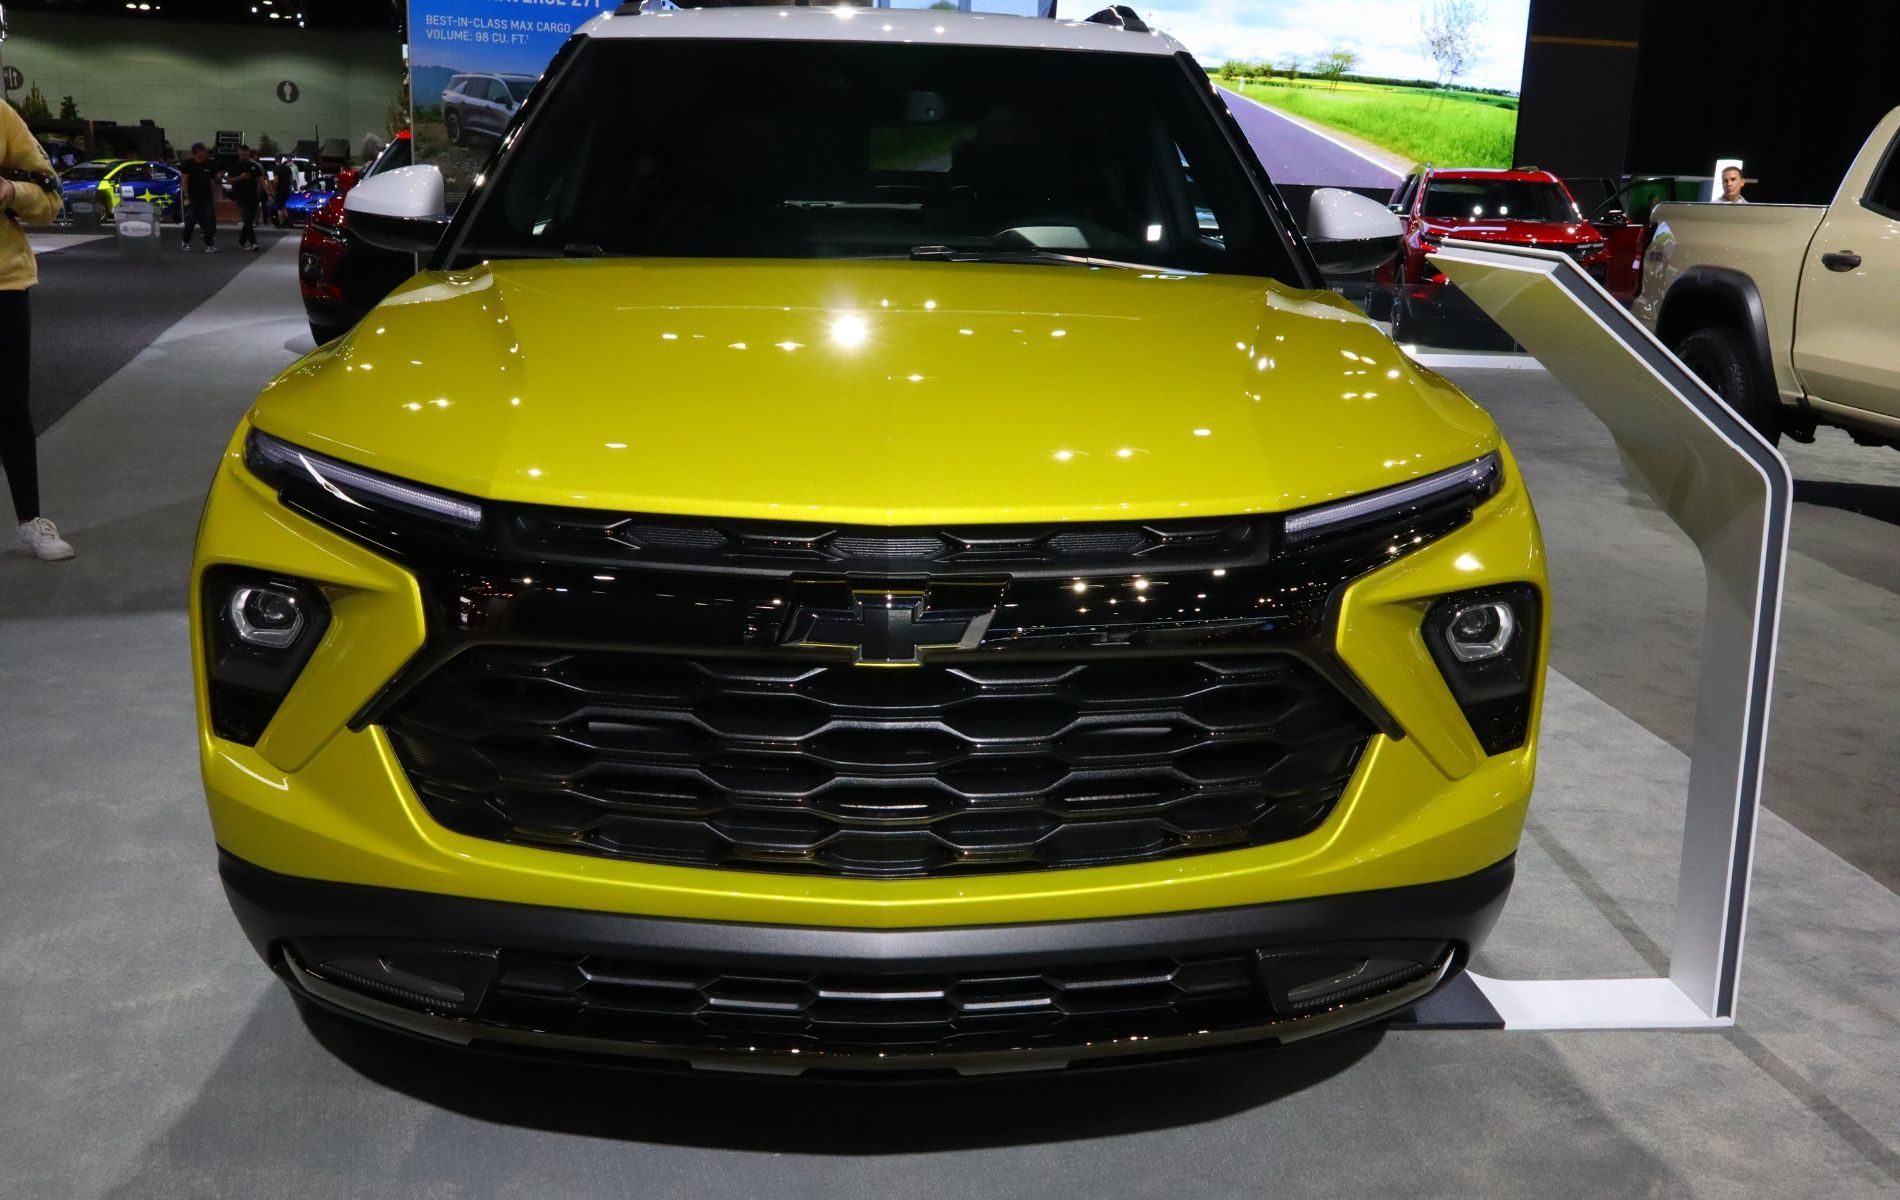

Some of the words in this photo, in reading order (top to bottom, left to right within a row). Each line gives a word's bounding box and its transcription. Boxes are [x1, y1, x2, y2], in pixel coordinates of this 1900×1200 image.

[426, 14, 508, 29] BEST-IN-CLASS
[510, 20, 534, 31] MAX
[537, 21, 571, 33] CARGO
[426, 29, 473, 41] VOLUME:
[475, 33, 489, 42] 98
[492, 33, 509, 43] CU.
